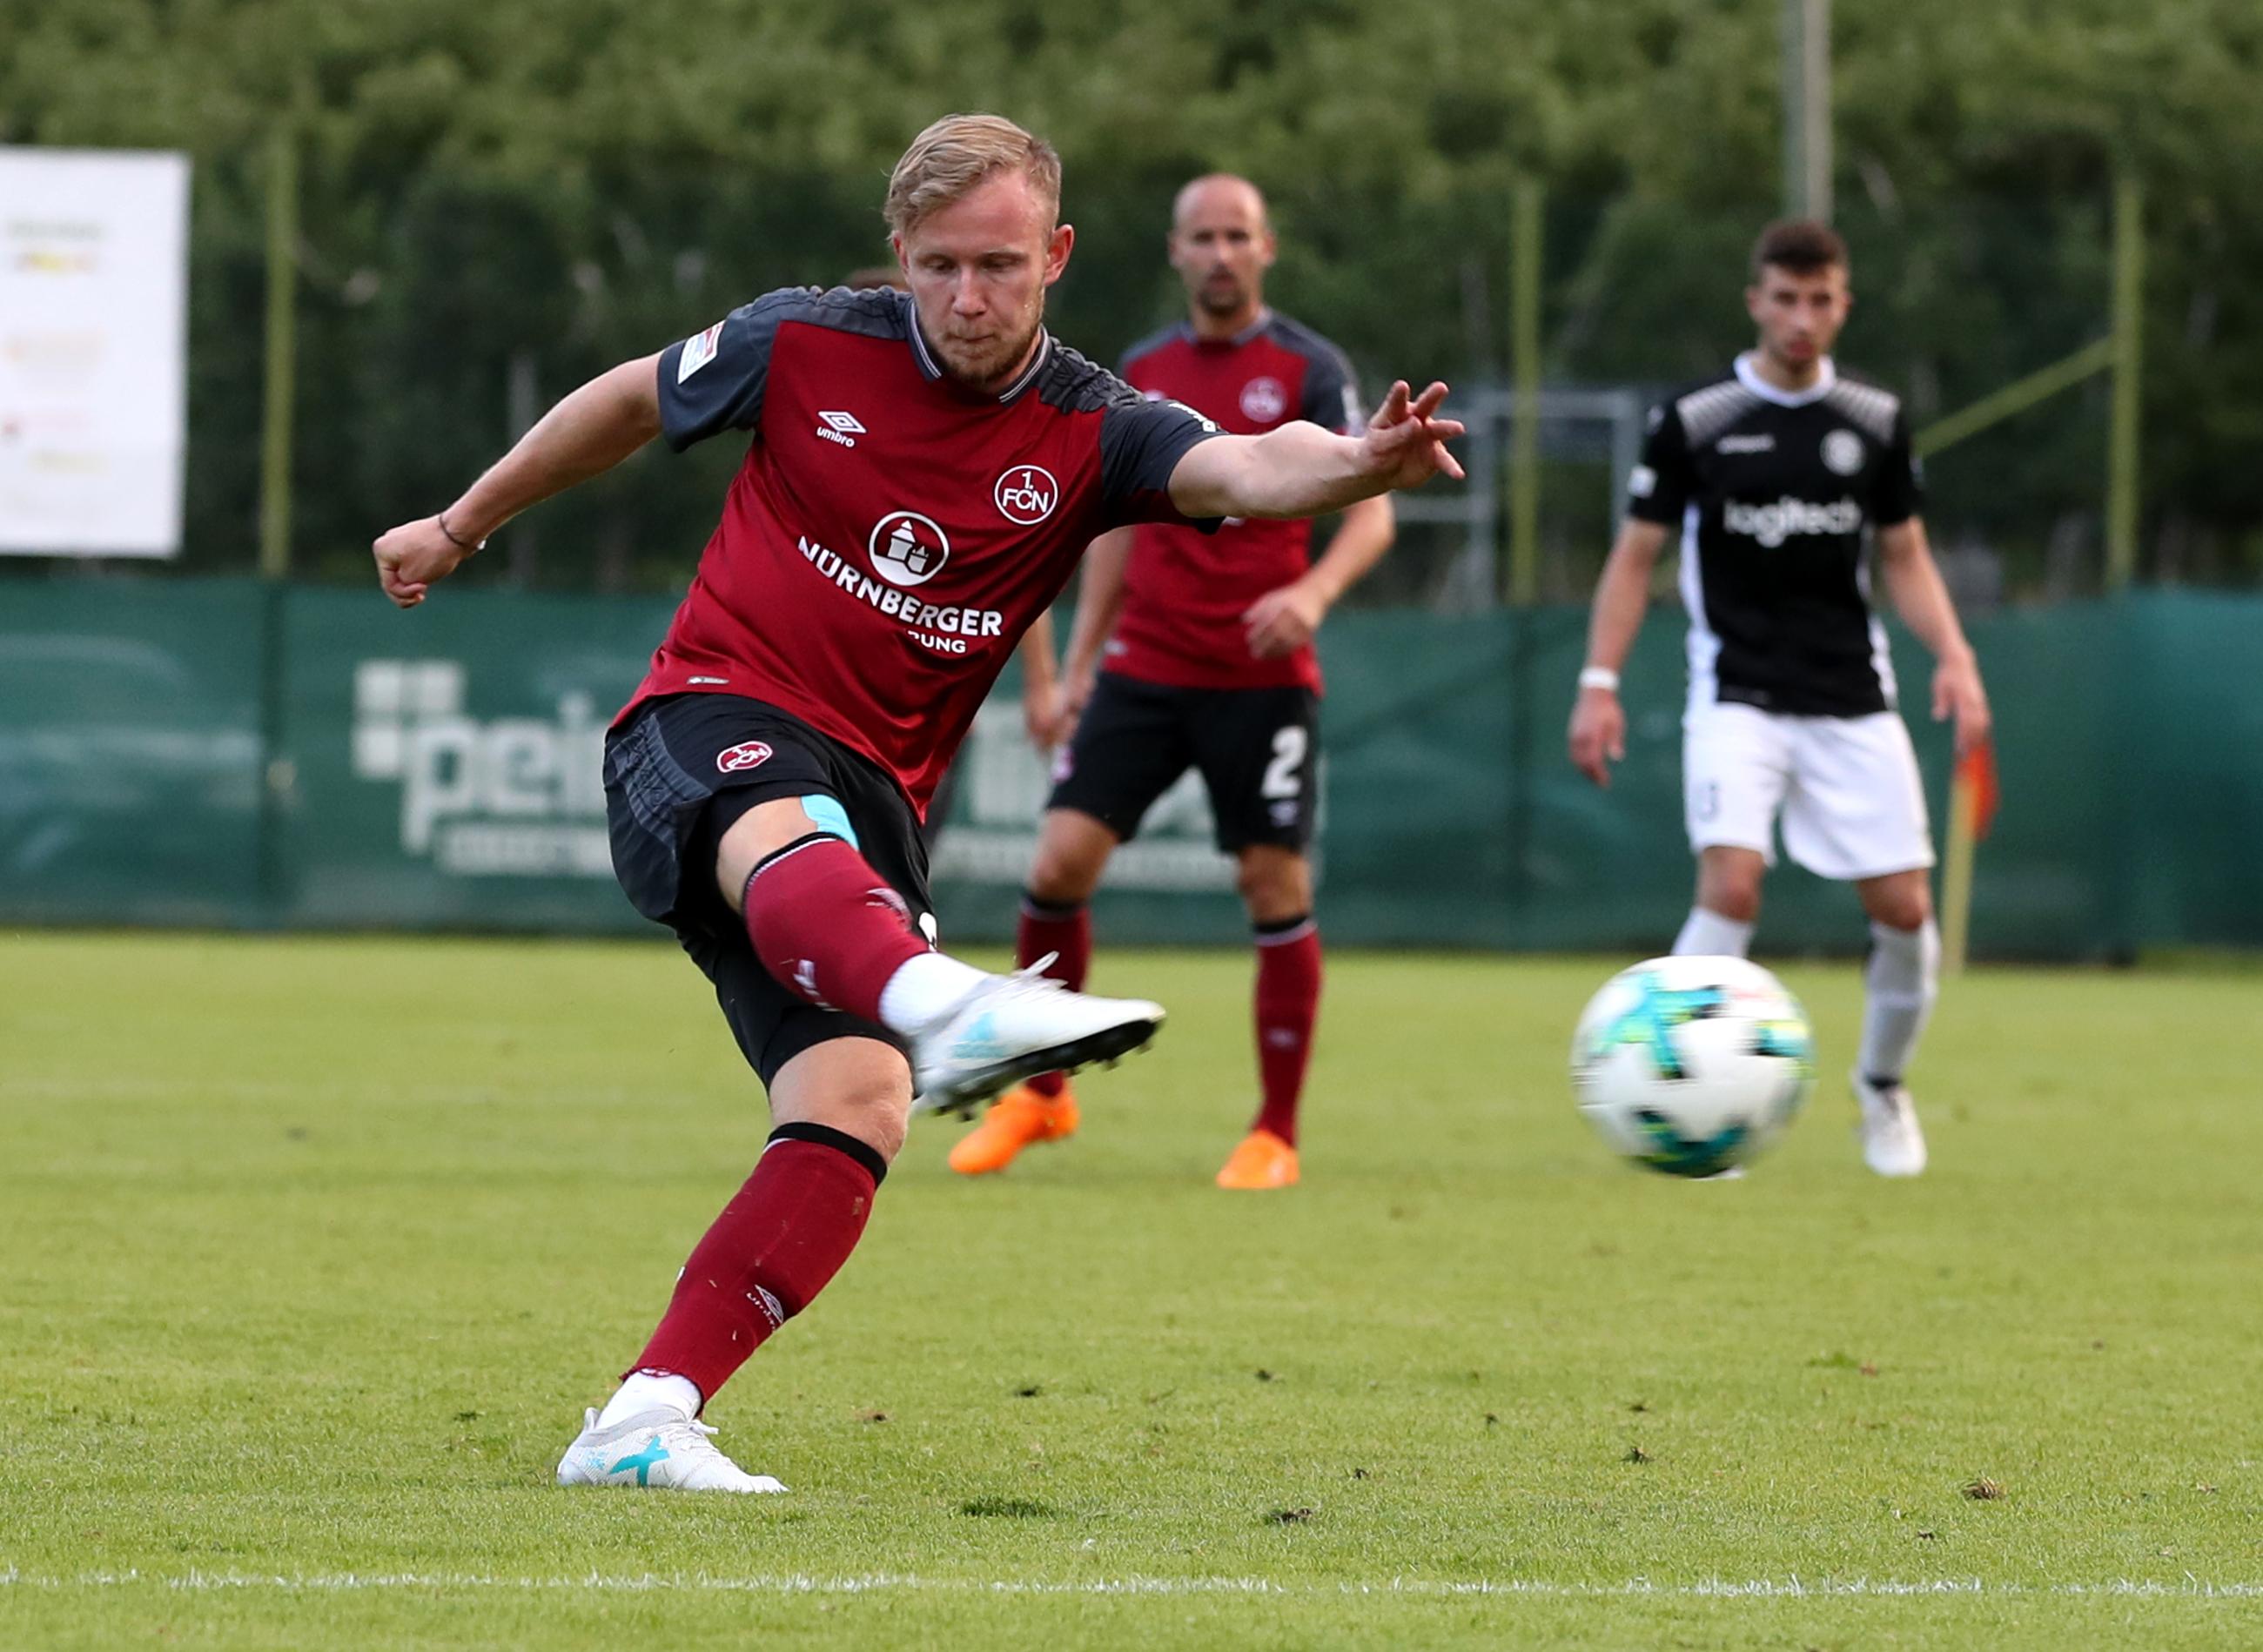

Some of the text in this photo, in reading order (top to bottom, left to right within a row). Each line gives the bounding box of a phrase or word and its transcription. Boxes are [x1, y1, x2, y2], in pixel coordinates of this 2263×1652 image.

[816, 426, 856, 448] umbro
[1002, 487, 1050, 514] FCN
[797, 534, 1003, 636] NÜRNBERGER
[1261, 724, 1307, 799] 2
